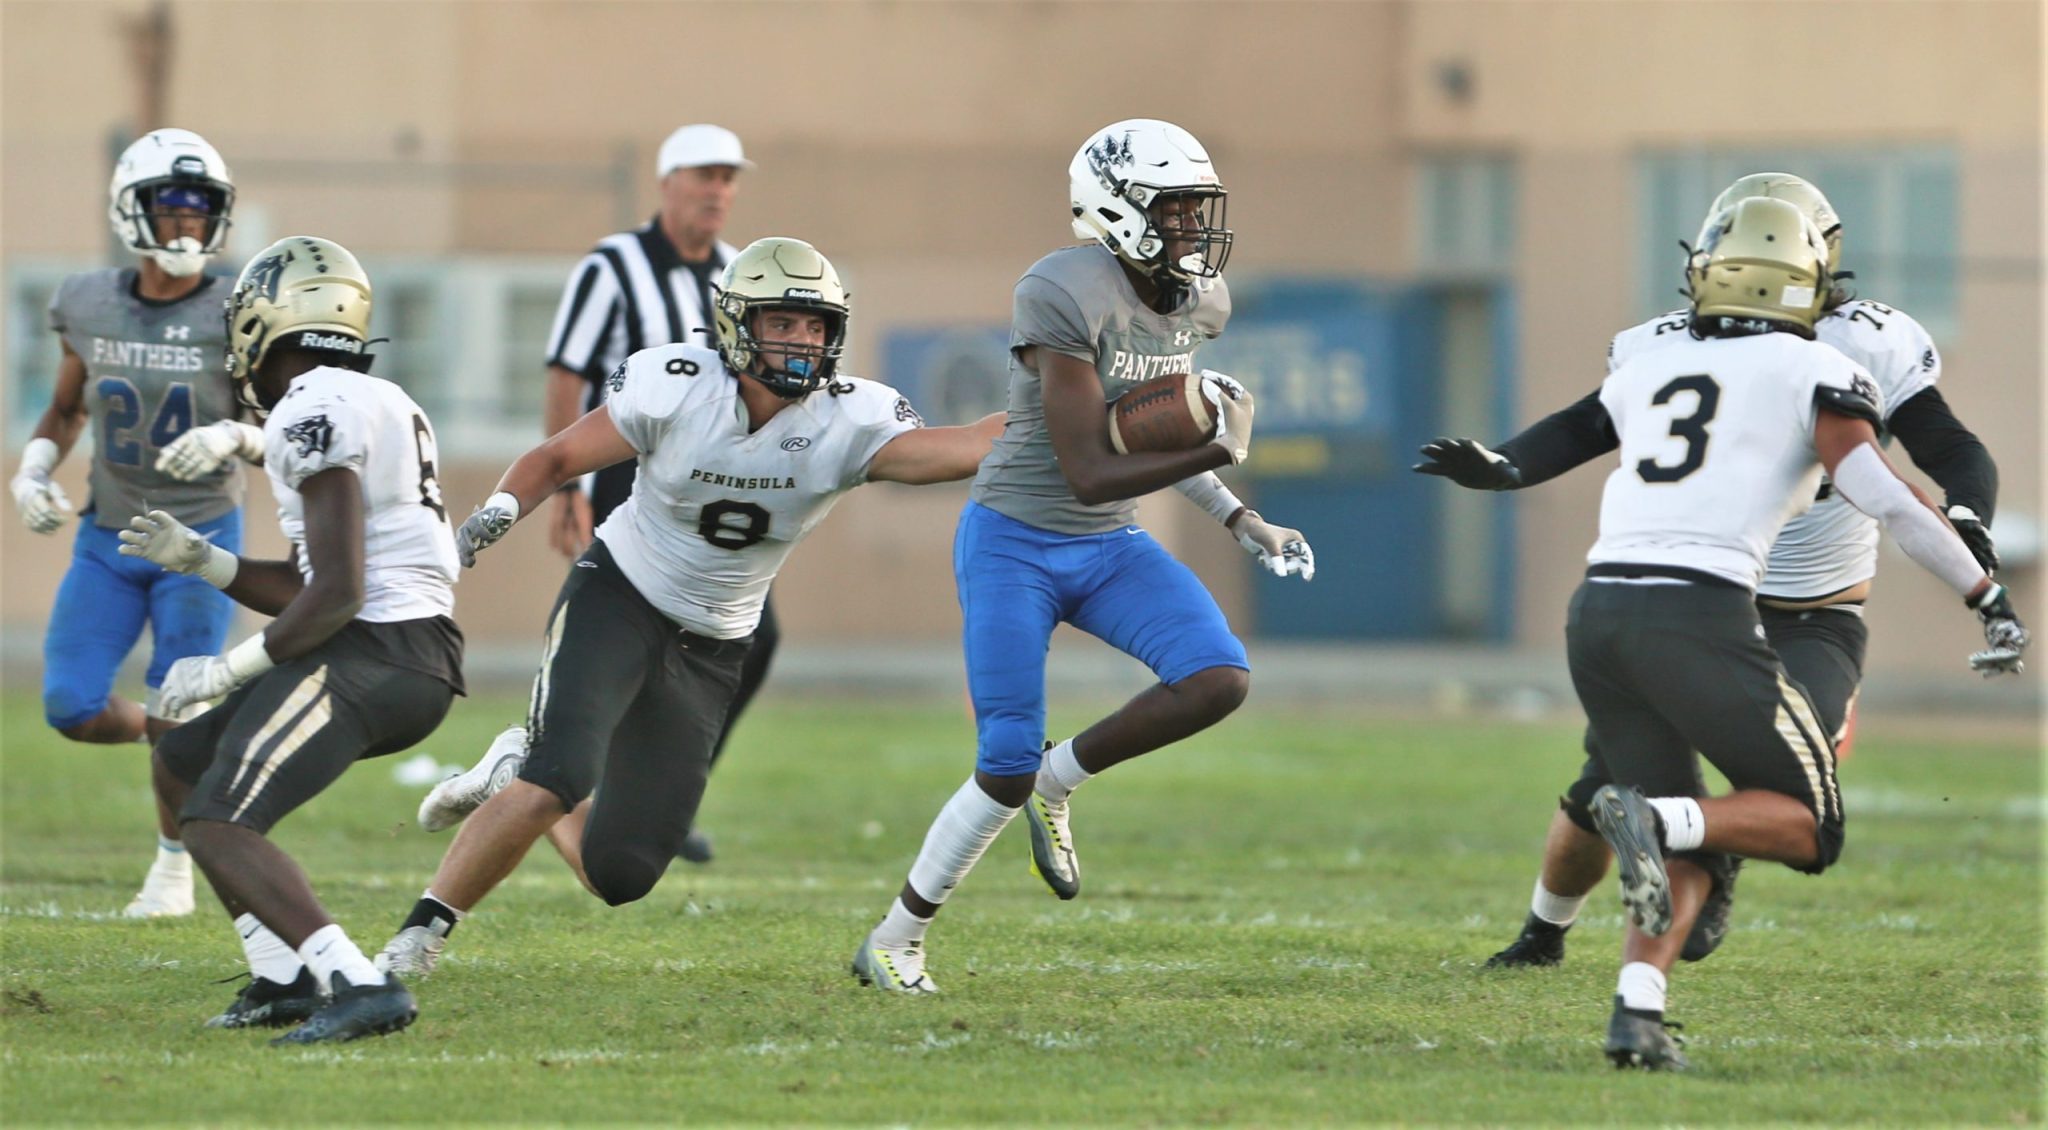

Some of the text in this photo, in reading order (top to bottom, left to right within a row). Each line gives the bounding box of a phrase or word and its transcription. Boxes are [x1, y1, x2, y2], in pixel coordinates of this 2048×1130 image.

[93, 337, 203, 371] PANTHERS
[665, 358, 699, 376] 8
[97, 375, 198, 469] 24
[1636, 374, 1721, 484] 3
[689, 468, 797, 490] PENINSULA
[698, 498, 771, 551] 8
